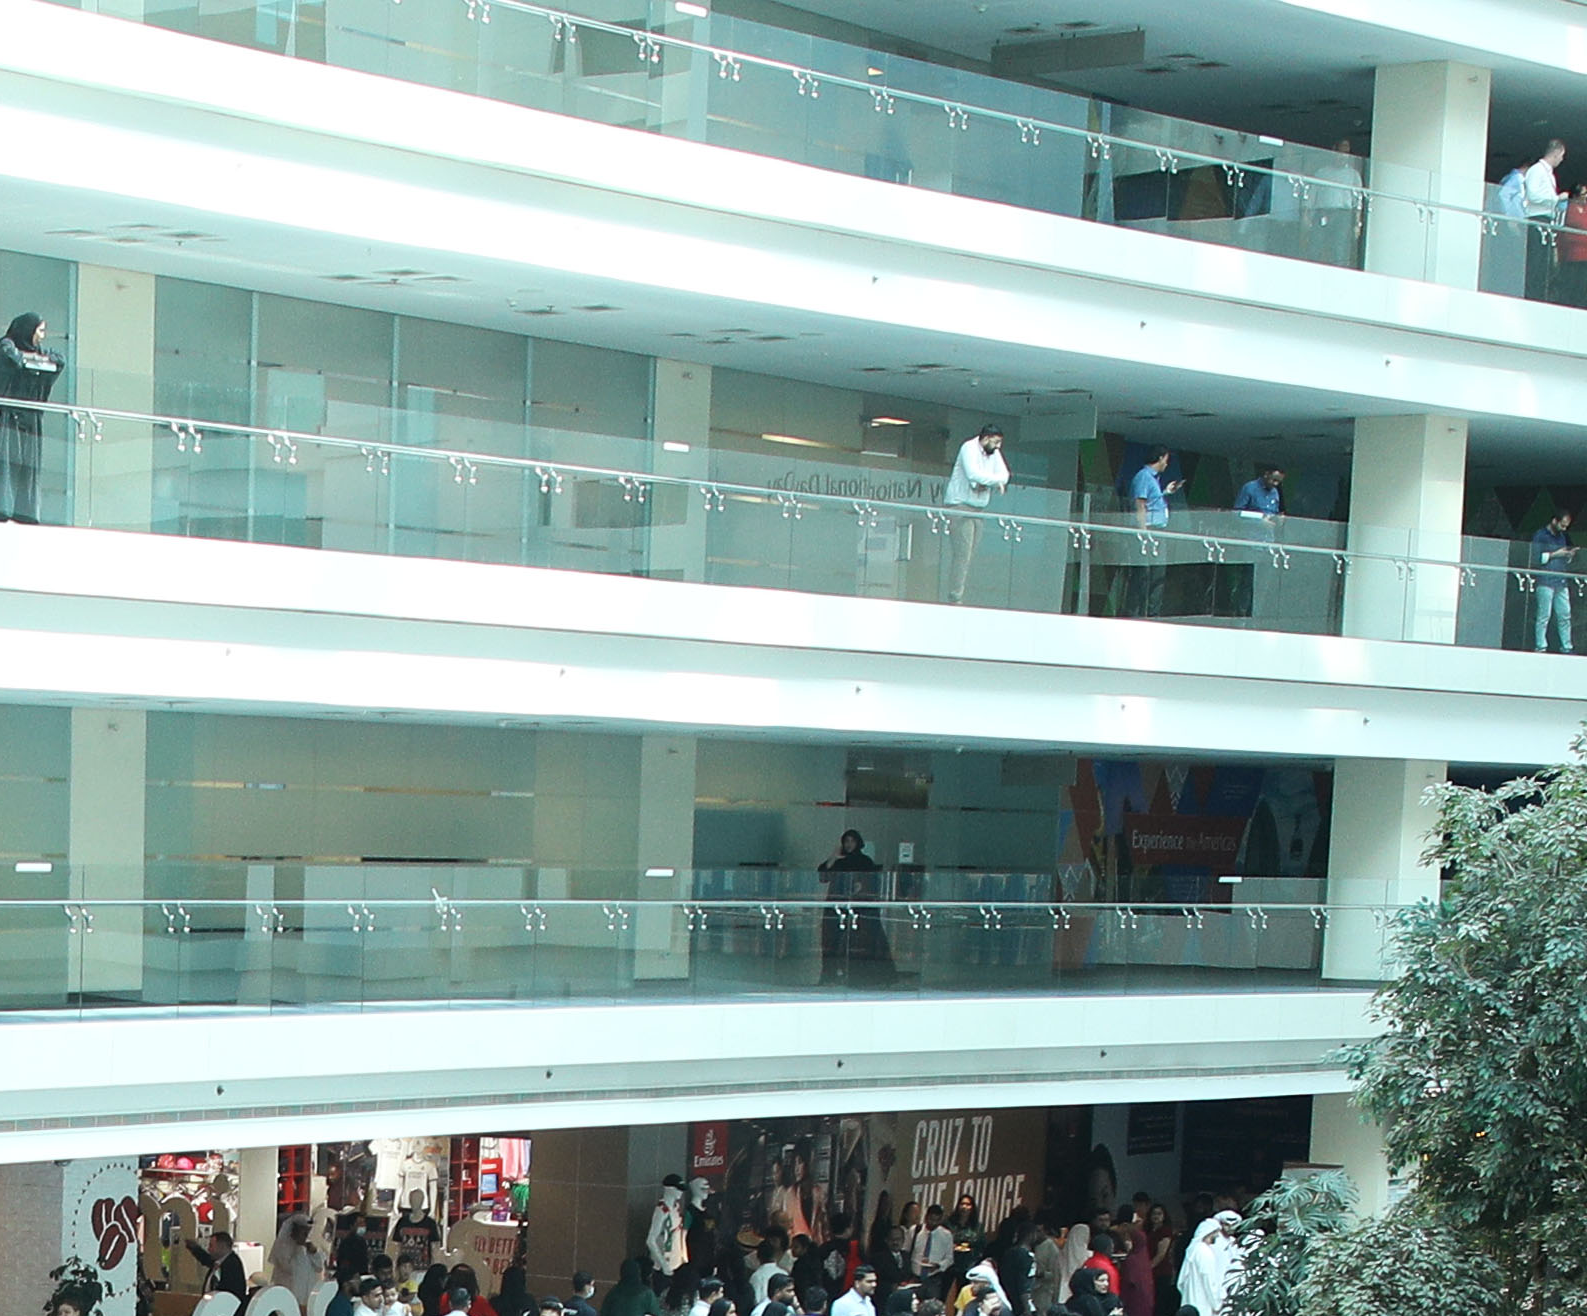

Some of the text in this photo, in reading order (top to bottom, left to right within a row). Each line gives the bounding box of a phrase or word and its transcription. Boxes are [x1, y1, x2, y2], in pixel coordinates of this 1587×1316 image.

[1131, 829, 1185, 853] Experience
[911, 1115, 994, 1179] CRUZ TO
[694, 1155, 725, 1168] Emirates
